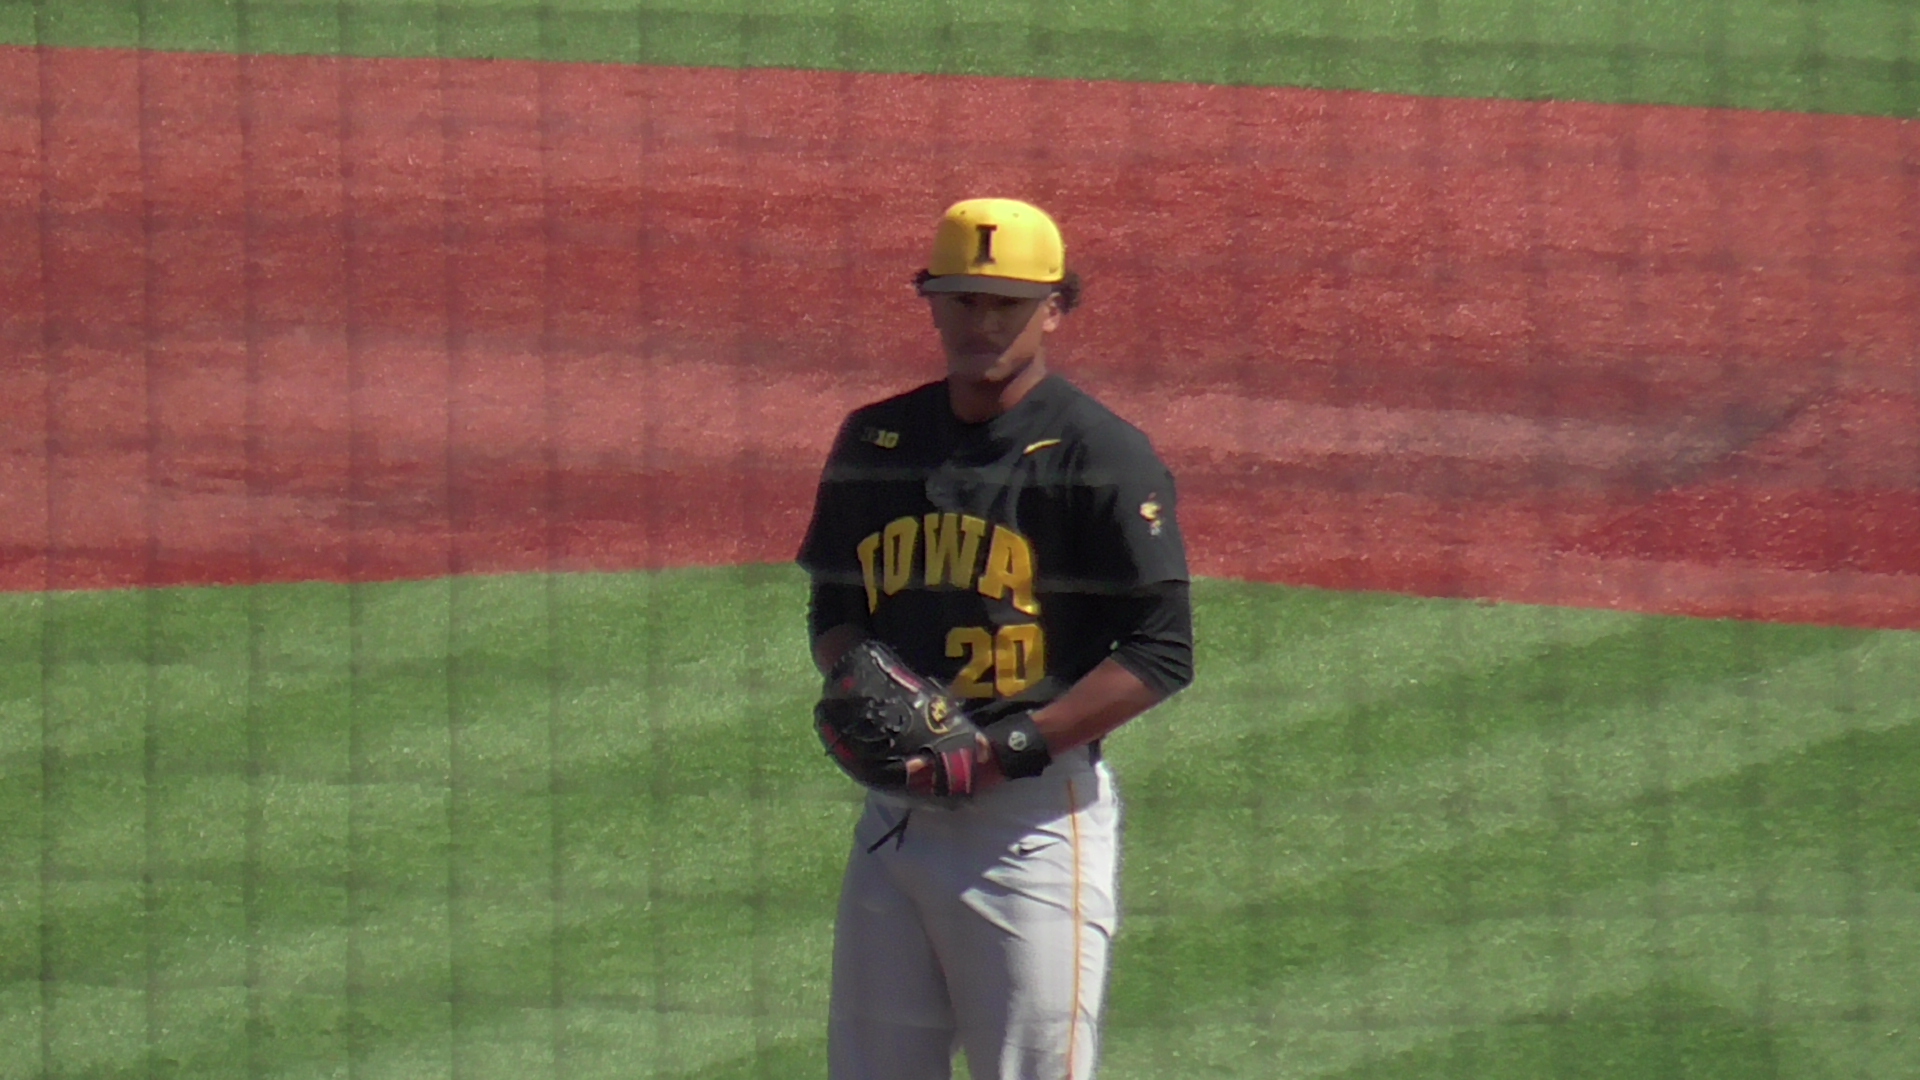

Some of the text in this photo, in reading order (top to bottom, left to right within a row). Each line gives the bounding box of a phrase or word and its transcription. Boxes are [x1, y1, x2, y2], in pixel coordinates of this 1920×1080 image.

[974, 224, 998, 265] I
[857, 513, 1040, 616] IOWA
[945, 623, 1046, 698] 20
